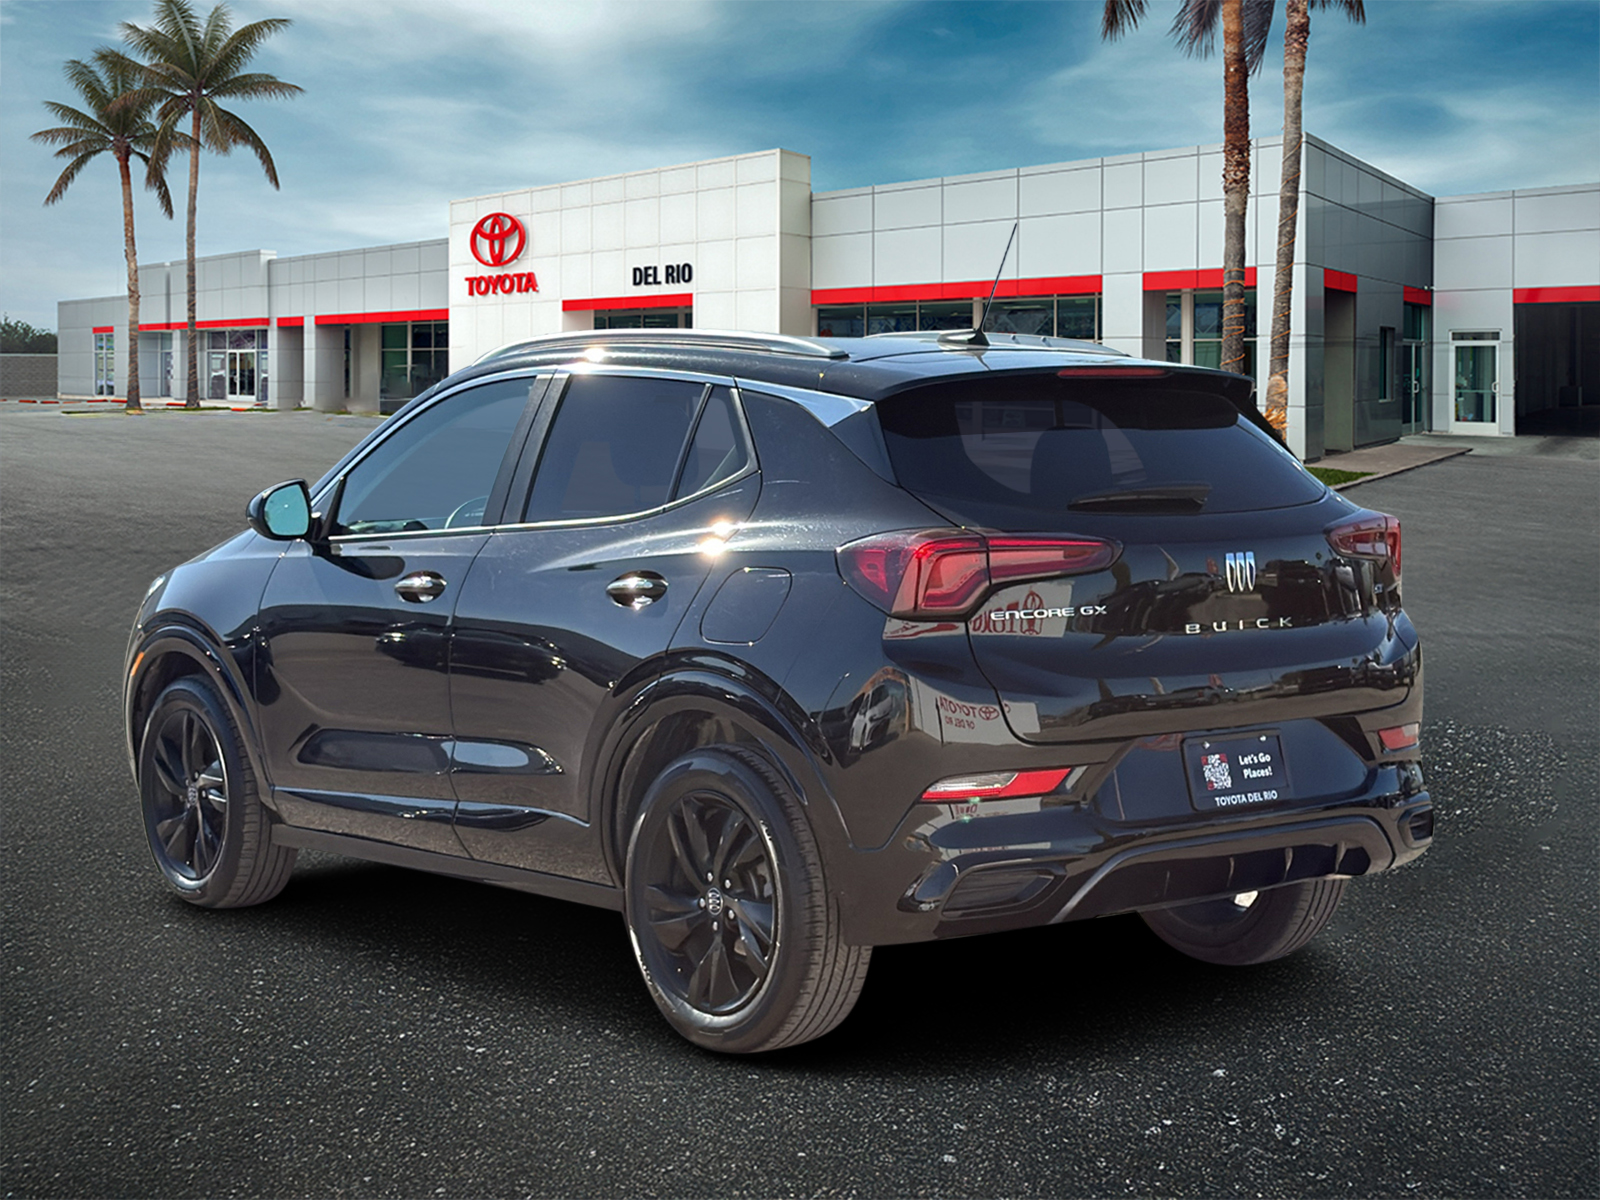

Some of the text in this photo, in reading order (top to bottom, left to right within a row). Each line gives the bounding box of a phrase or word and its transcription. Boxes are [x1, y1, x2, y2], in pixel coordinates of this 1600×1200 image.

[632, 263, 693, 286] DEL RIO
[465, 272, 539, 296] TOYOTA
[990, 605, 1107, 621] ENCORE GX
[1185, 617, 1292, 634] BUICK
[1238, 752, 1271, 766] Let's Go
[1243, 766, 1272, 779] Places!
[1215, 790, 1278, 806] TOYOTA DEL RIO
